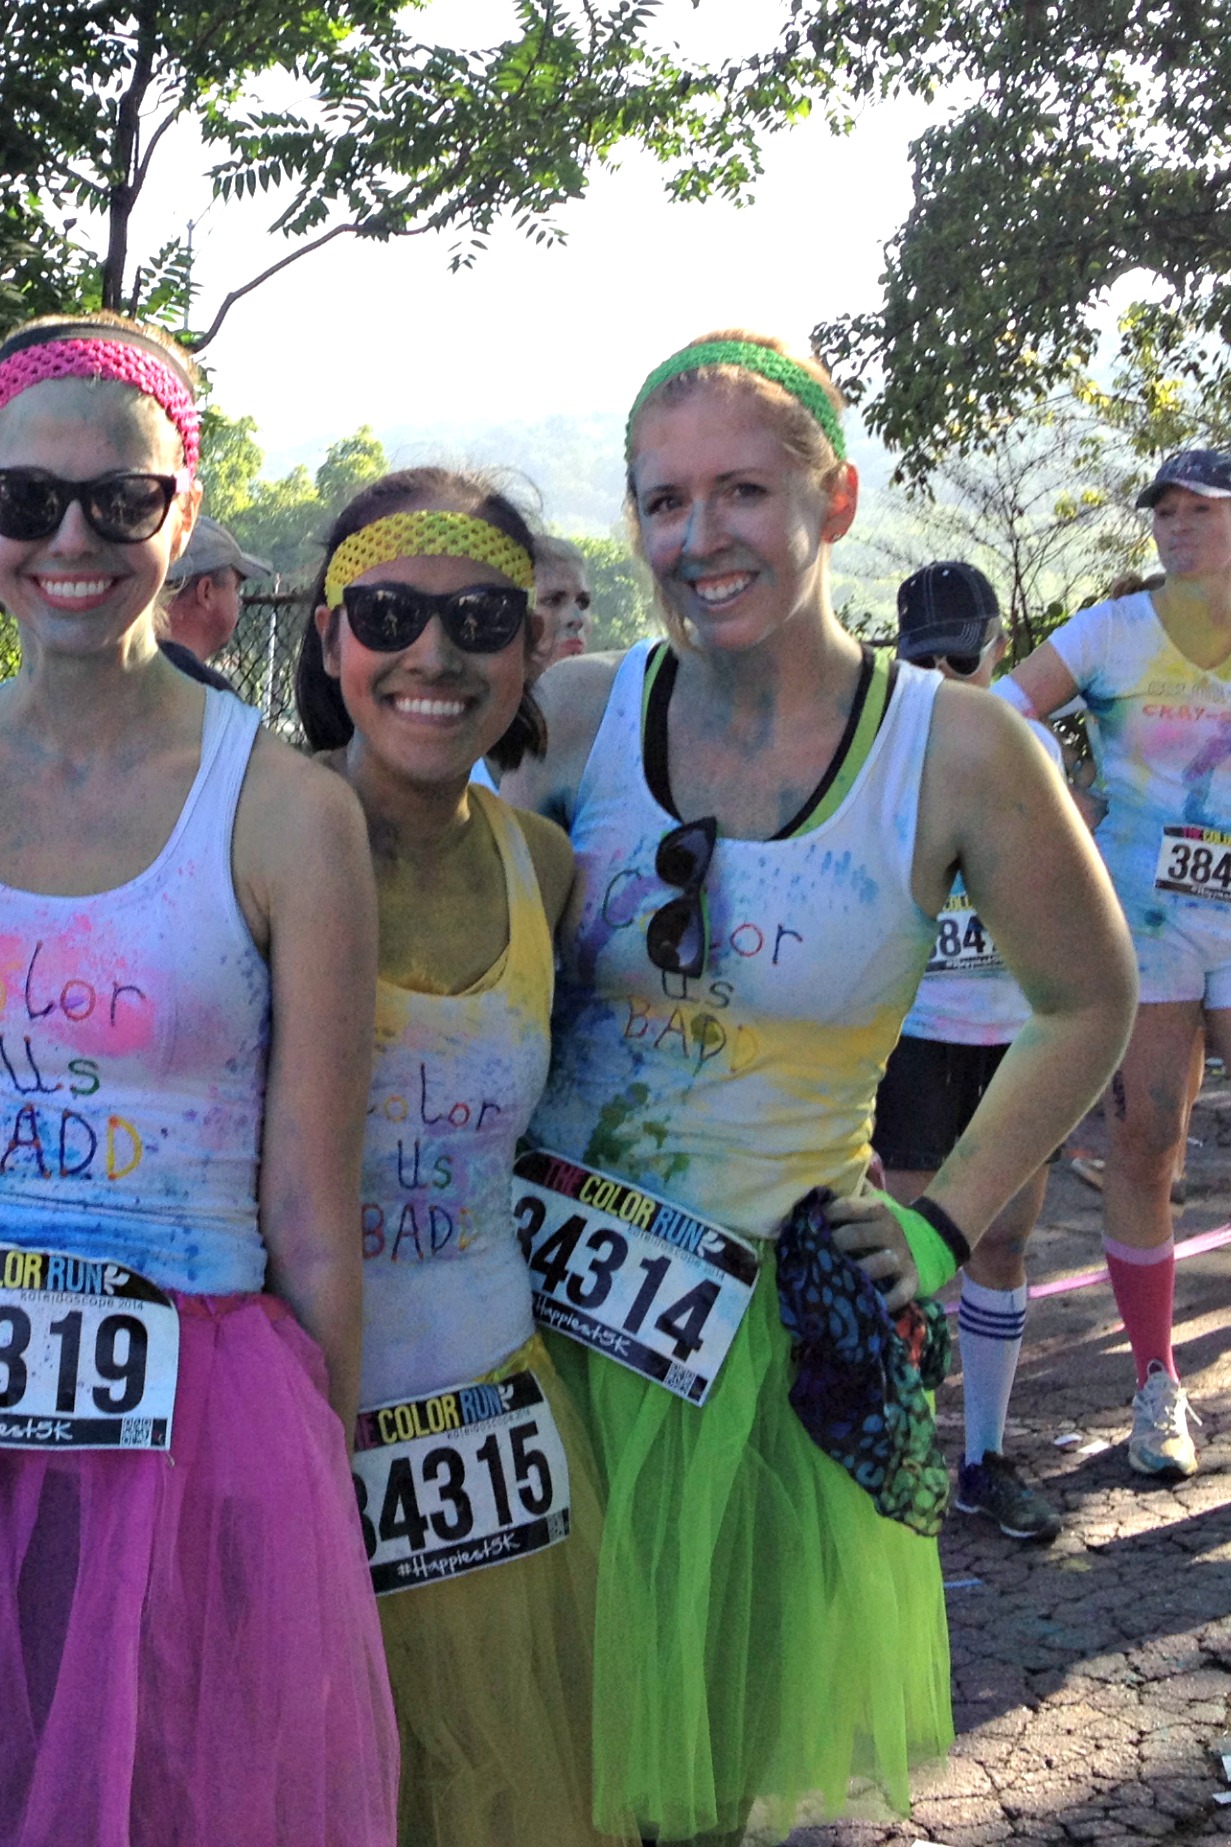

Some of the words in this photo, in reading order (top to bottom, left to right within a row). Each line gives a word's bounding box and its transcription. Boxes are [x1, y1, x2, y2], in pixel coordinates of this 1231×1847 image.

[543, 1159, 586, 1198] THE
[579, 1175, 656, 1230] COLOR
[651, 1206, 705, 1254] RUN
[46, 1257, 105, 1295] RUN
[378, 1393, 460, 1444] COLOR
[460, 1384, 505, 1426] RUN
